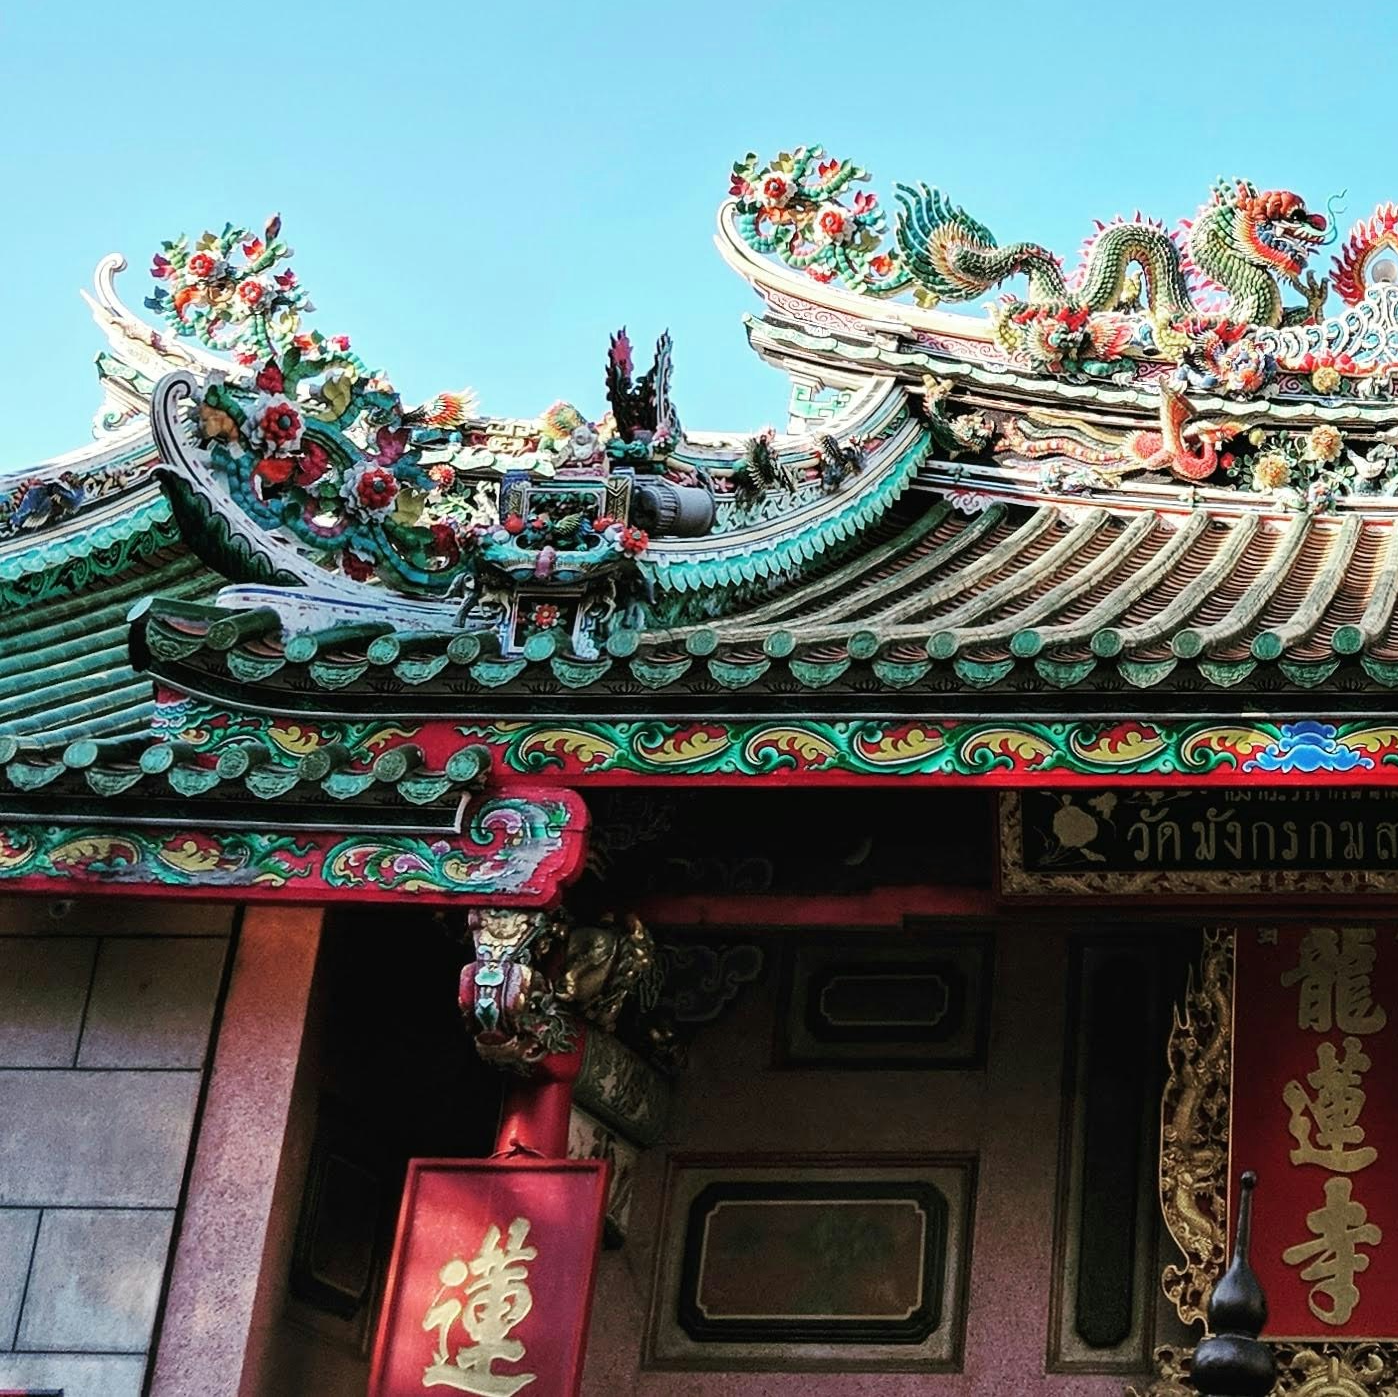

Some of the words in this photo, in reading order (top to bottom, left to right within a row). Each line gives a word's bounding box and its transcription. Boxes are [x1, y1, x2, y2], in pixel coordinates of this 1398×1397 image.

[1280, 927, 1387, 1326] 龍蓮寺
[422, 1216, 538, 1397] 蓮
